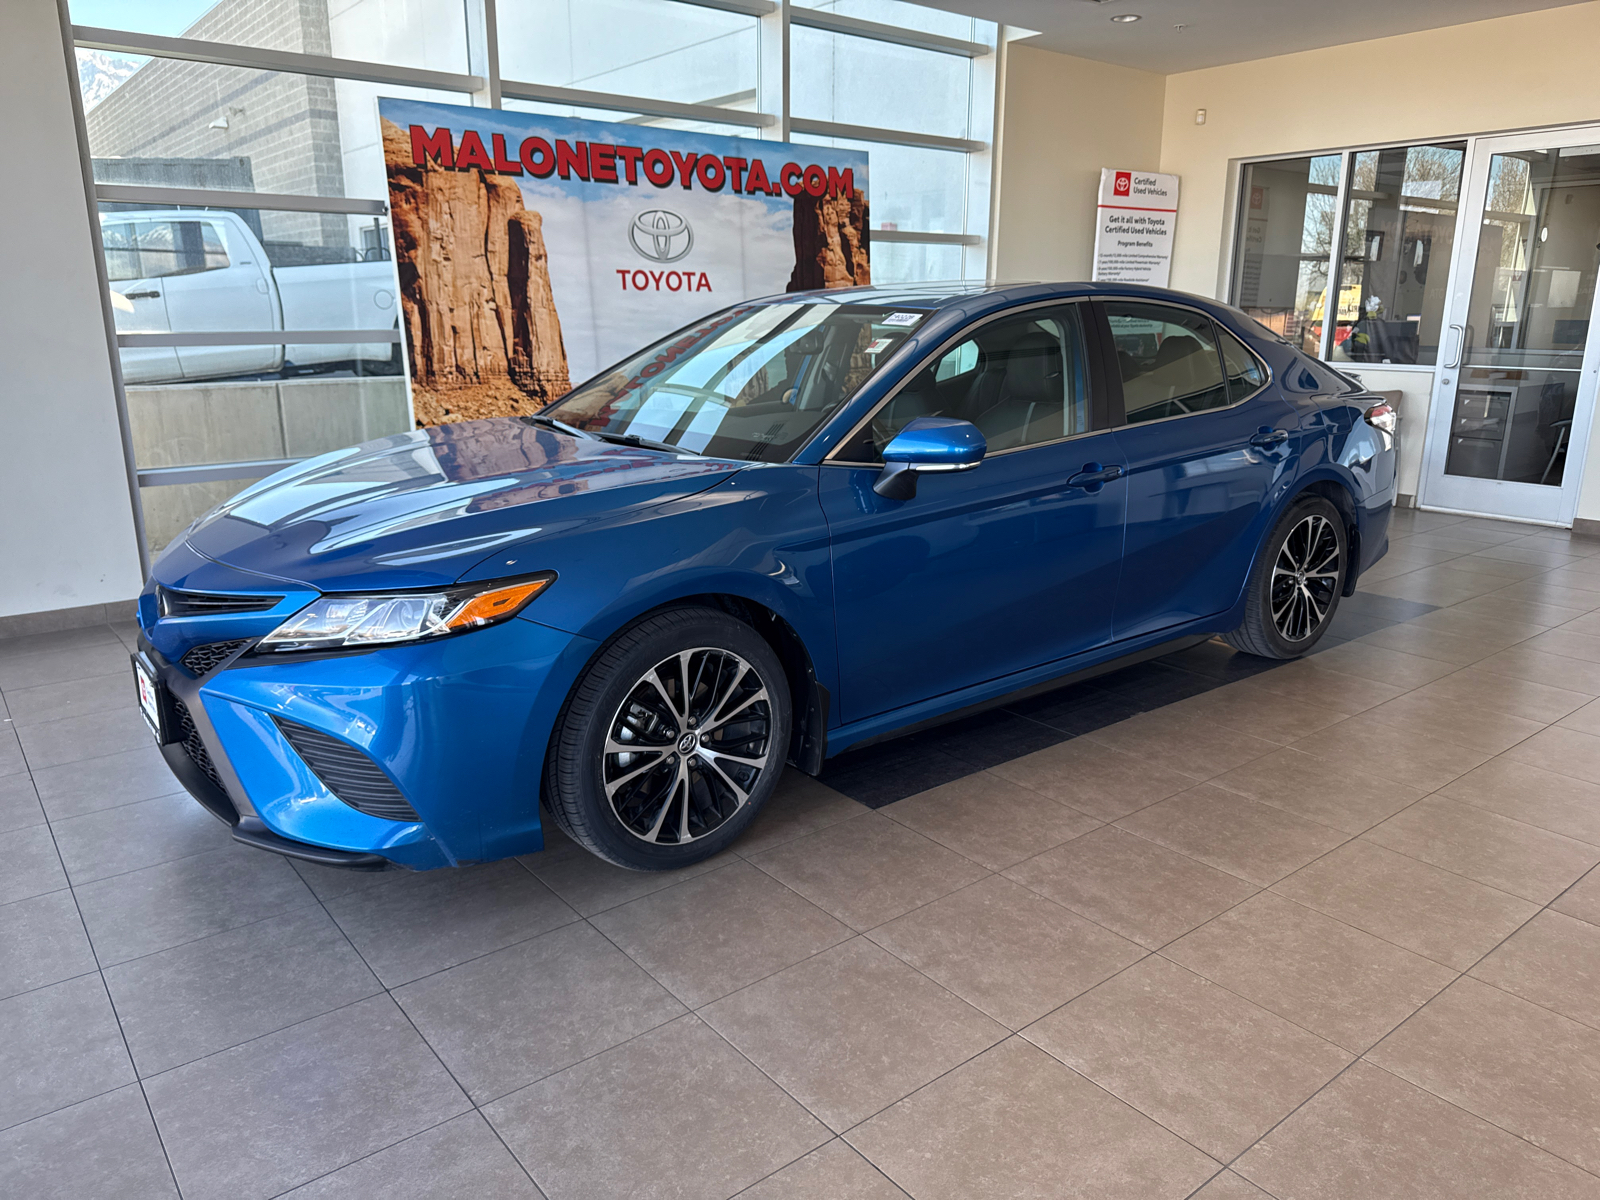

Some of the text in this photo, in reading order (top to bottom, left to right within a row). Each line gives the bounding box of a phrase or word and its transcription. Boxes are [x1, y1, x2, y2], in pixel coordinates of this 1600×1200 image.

[409, 124, 854, 199] MALONETOYOTA.COM
[1134, 177, 1156, 186] Certified
[1133, 187, 1167, 196] Used Vehicles
[1109, 215, 1120, 223] Get
[1121, 215, 1125, 223] it
[1147, 217, 1165, 226] Toyota
[1105, 225, 1130, 234] Certified
[1145, 227, 1167, 236] Vehicles
[1117, 240, 1135, 248] Program
[616, 269, 713, 292] TOYOTA
